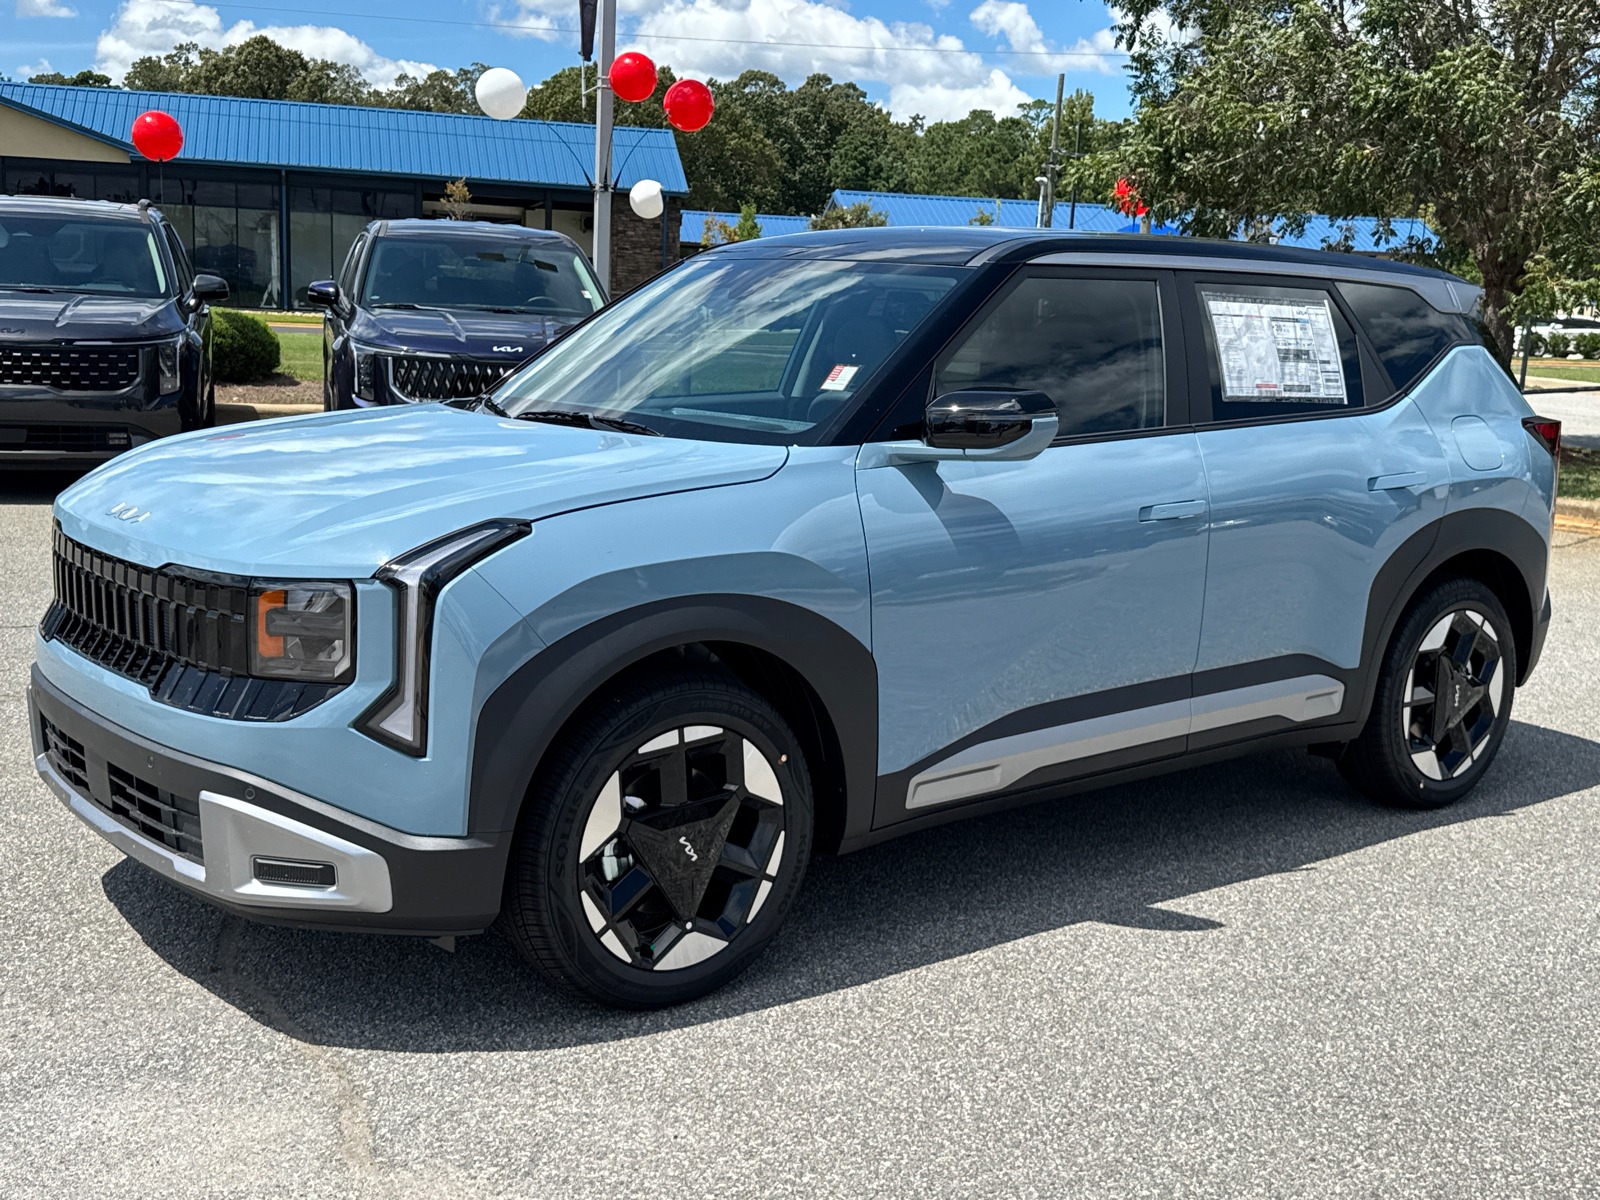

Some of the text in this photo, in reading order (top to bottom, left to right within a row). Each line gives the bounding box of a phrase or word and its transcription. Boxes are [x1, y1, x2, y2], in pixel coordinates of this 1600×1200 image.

[492, 345, 523, 353] KIA
[104, 502, 152, 524] KIA
[678, 836, 698, 862] KIA
[778, 833, 808, 915] KUMHO
